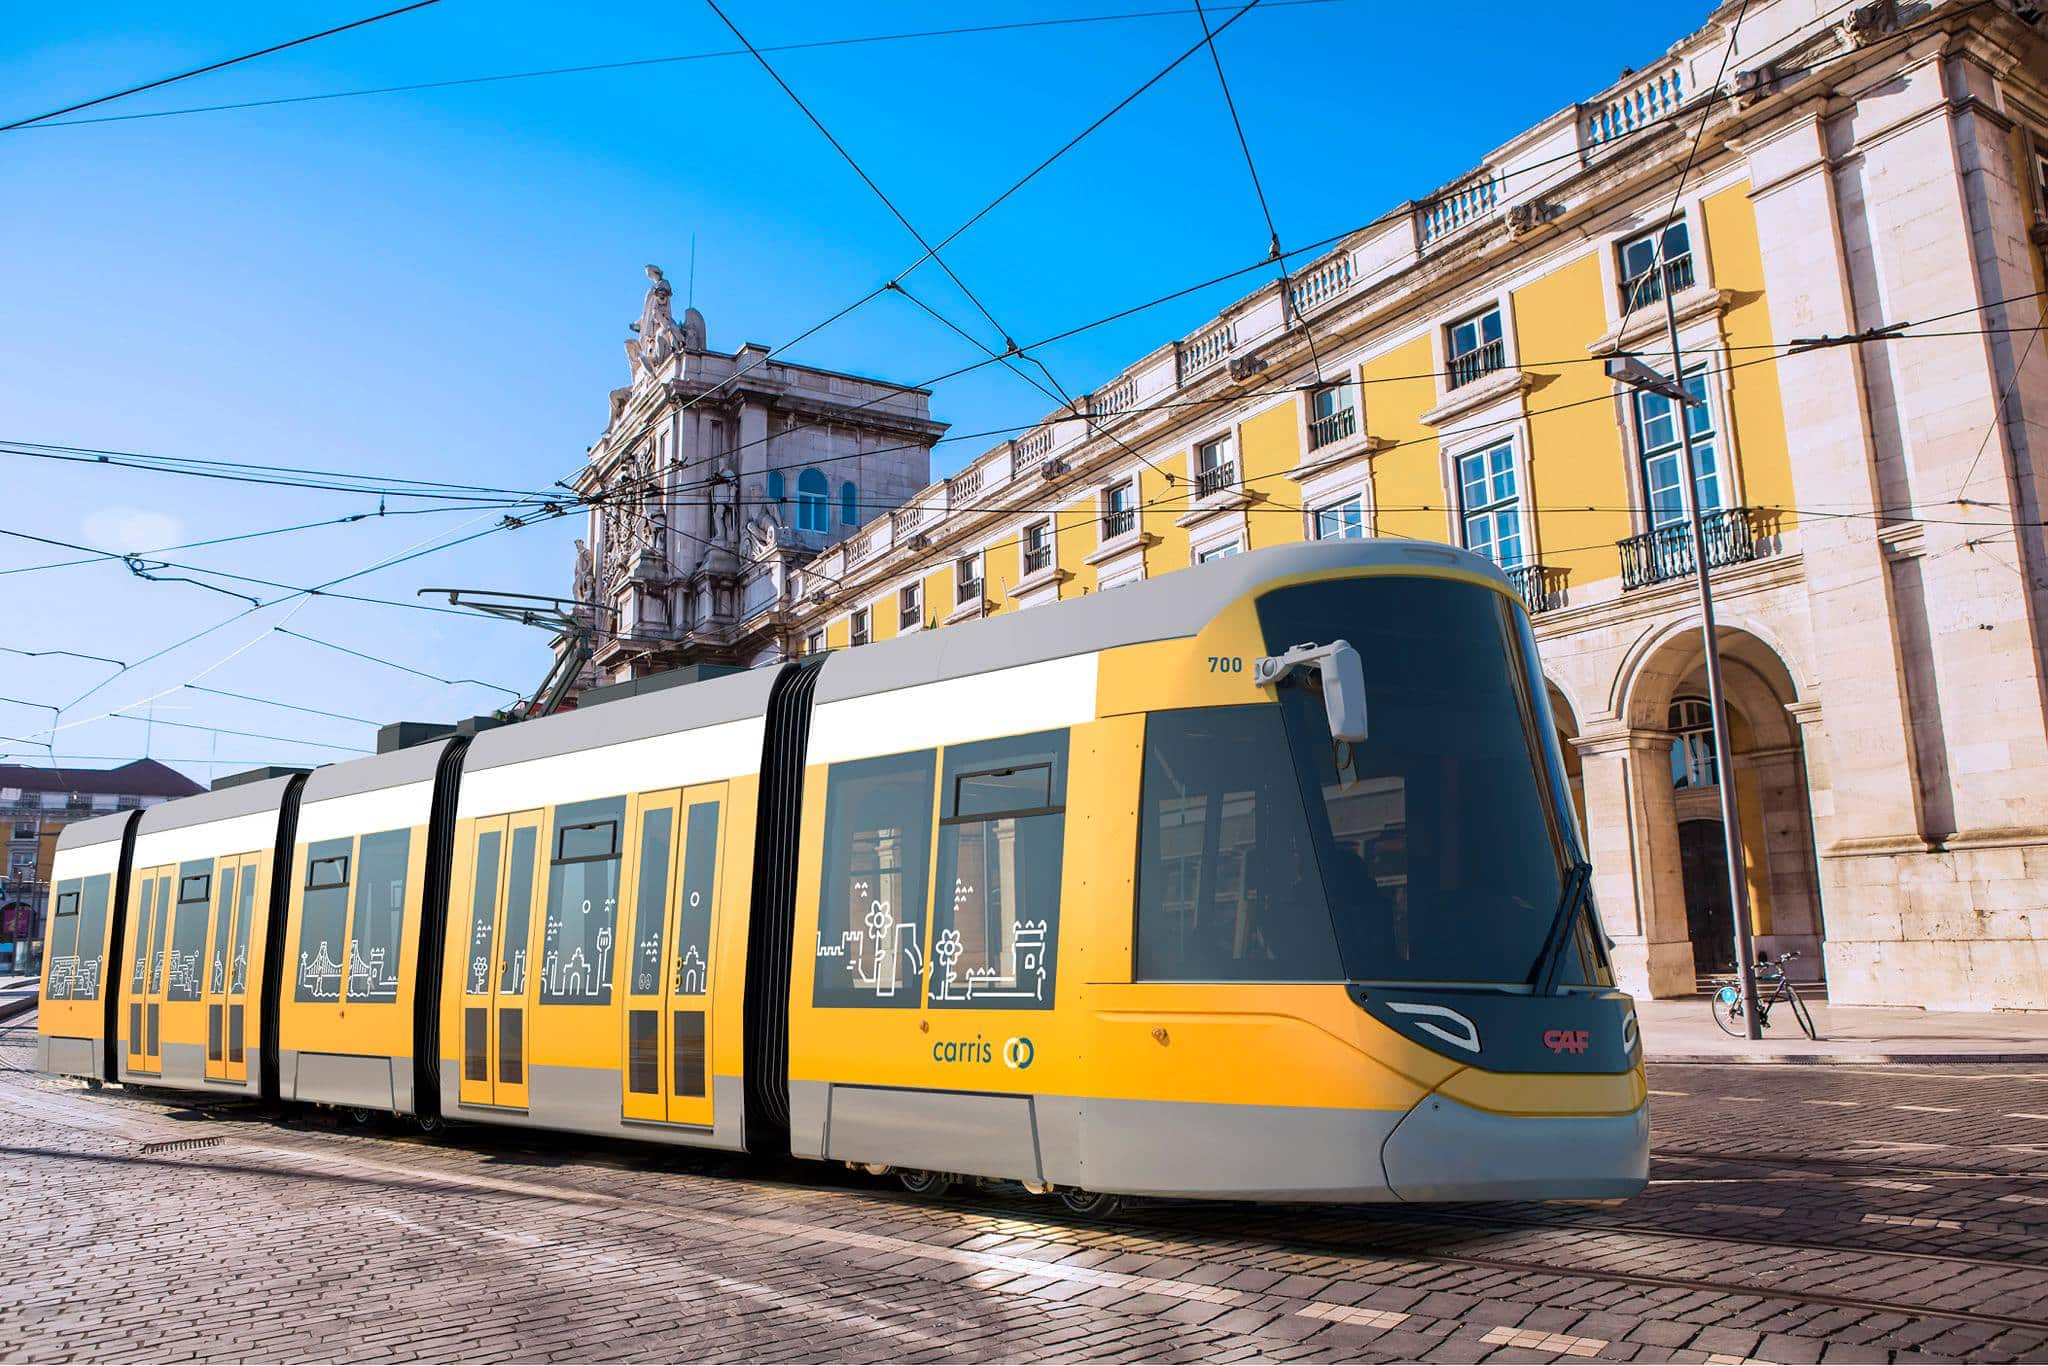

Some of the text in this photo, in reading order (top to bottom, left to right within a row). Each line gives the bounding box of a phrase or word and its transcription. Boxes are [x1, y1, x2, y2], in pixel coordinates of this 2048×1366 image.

[1208, 656, 1242, 672] 700
[933, 1034, 992, 1063] carris
[1543, 1030, 1590, 1054] CAF
